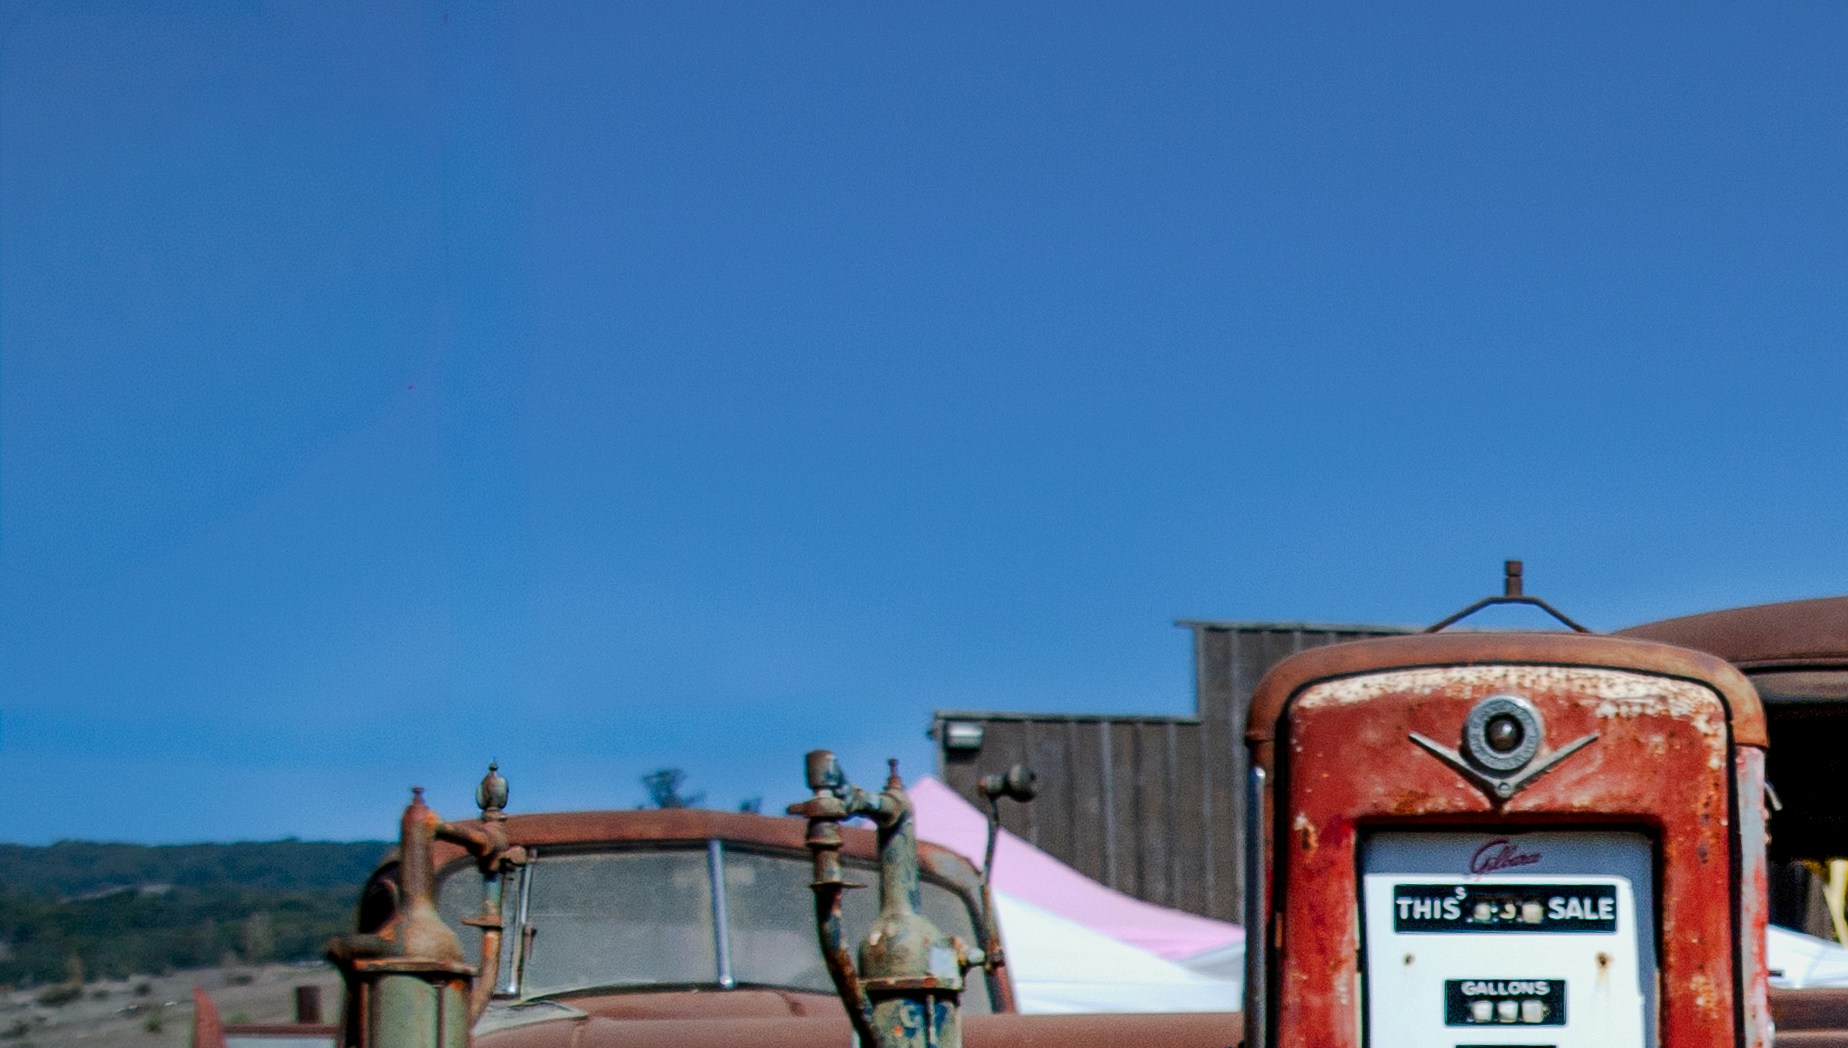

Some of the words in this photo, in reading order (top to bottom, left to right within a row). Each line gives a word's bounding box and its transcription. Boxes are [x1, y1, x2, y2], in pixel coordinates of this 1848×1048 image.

[1396, 897, 1461, 920] THIS
[1548, 896, 1615, 920] SALE
[1461, 981, 1550, 996] GALLONS
